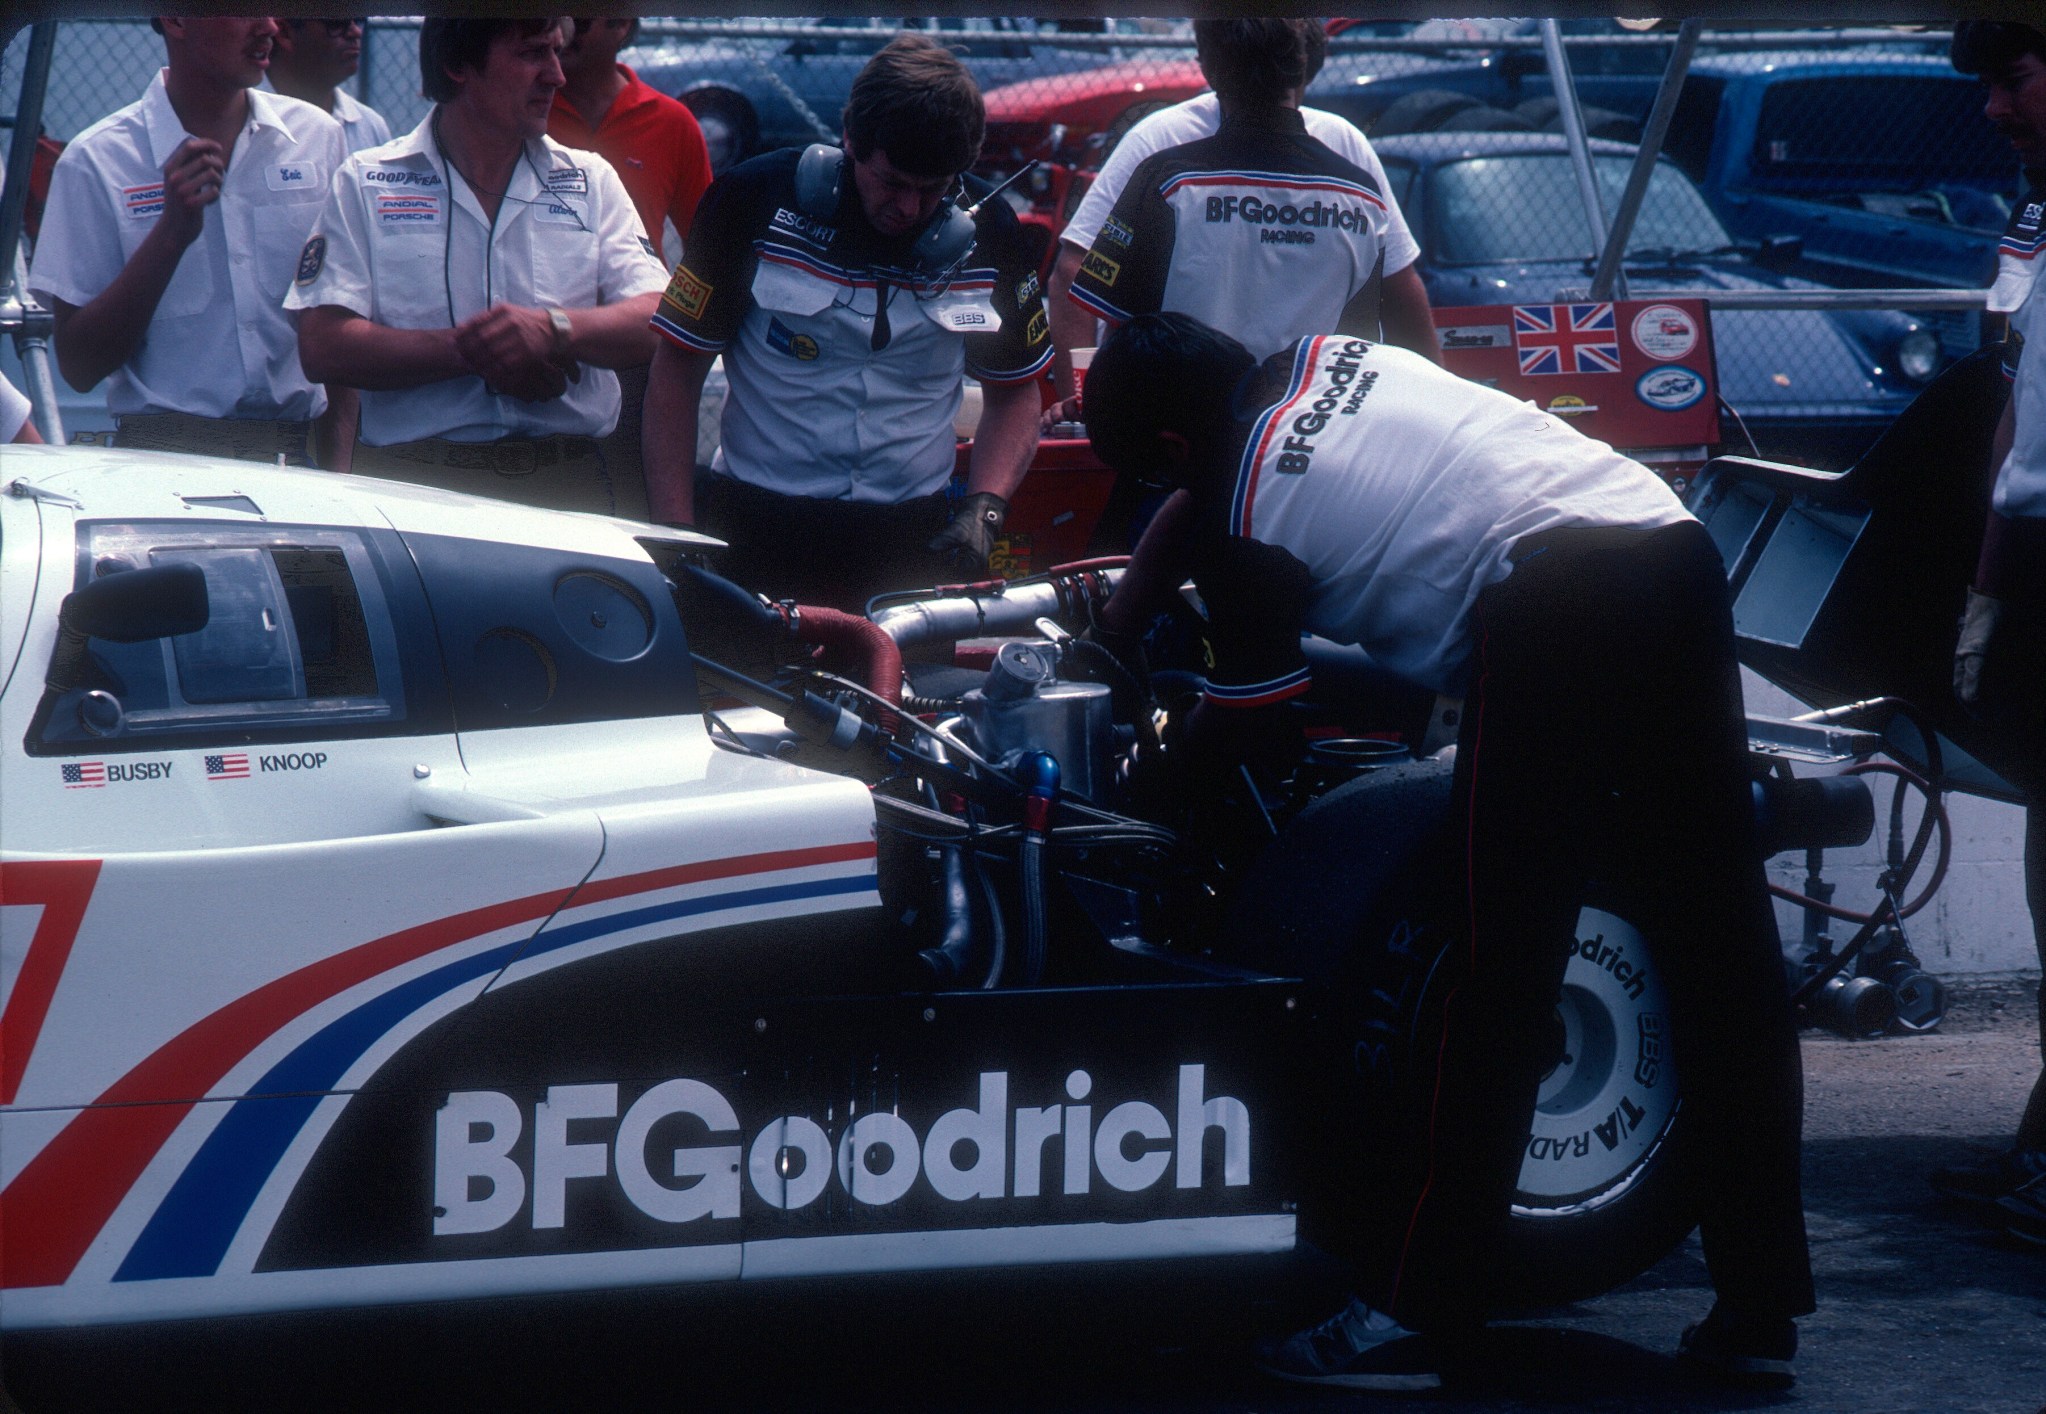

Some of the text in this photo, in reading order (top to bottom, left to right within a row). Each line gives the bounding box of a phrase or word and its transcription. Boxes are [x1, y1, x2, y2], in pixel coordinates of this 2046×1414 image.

[280, 168, 302, 181] Eric
[366, 171, 442, 186] GOODYEA
[383, 213, 434, 221] PORSCHE
[774, 207, 837, 242] ESCORT
[1206, 196, 1369, 235] BFGoodrich
[1261, 228, 1315, 245] RACING
[952, 312, 985, 325] BBS
[1341, 371, 1379, 415] RACING
[107, 762, 173, 782] BUSBY
[259, 752, 328, 772] KNOOP
[1634, 1012, 1663, 1089] BBS
[1594, 1096, 1646, 1151] T/A
[433, 1064, 1250, 1236] BFGoodrich
